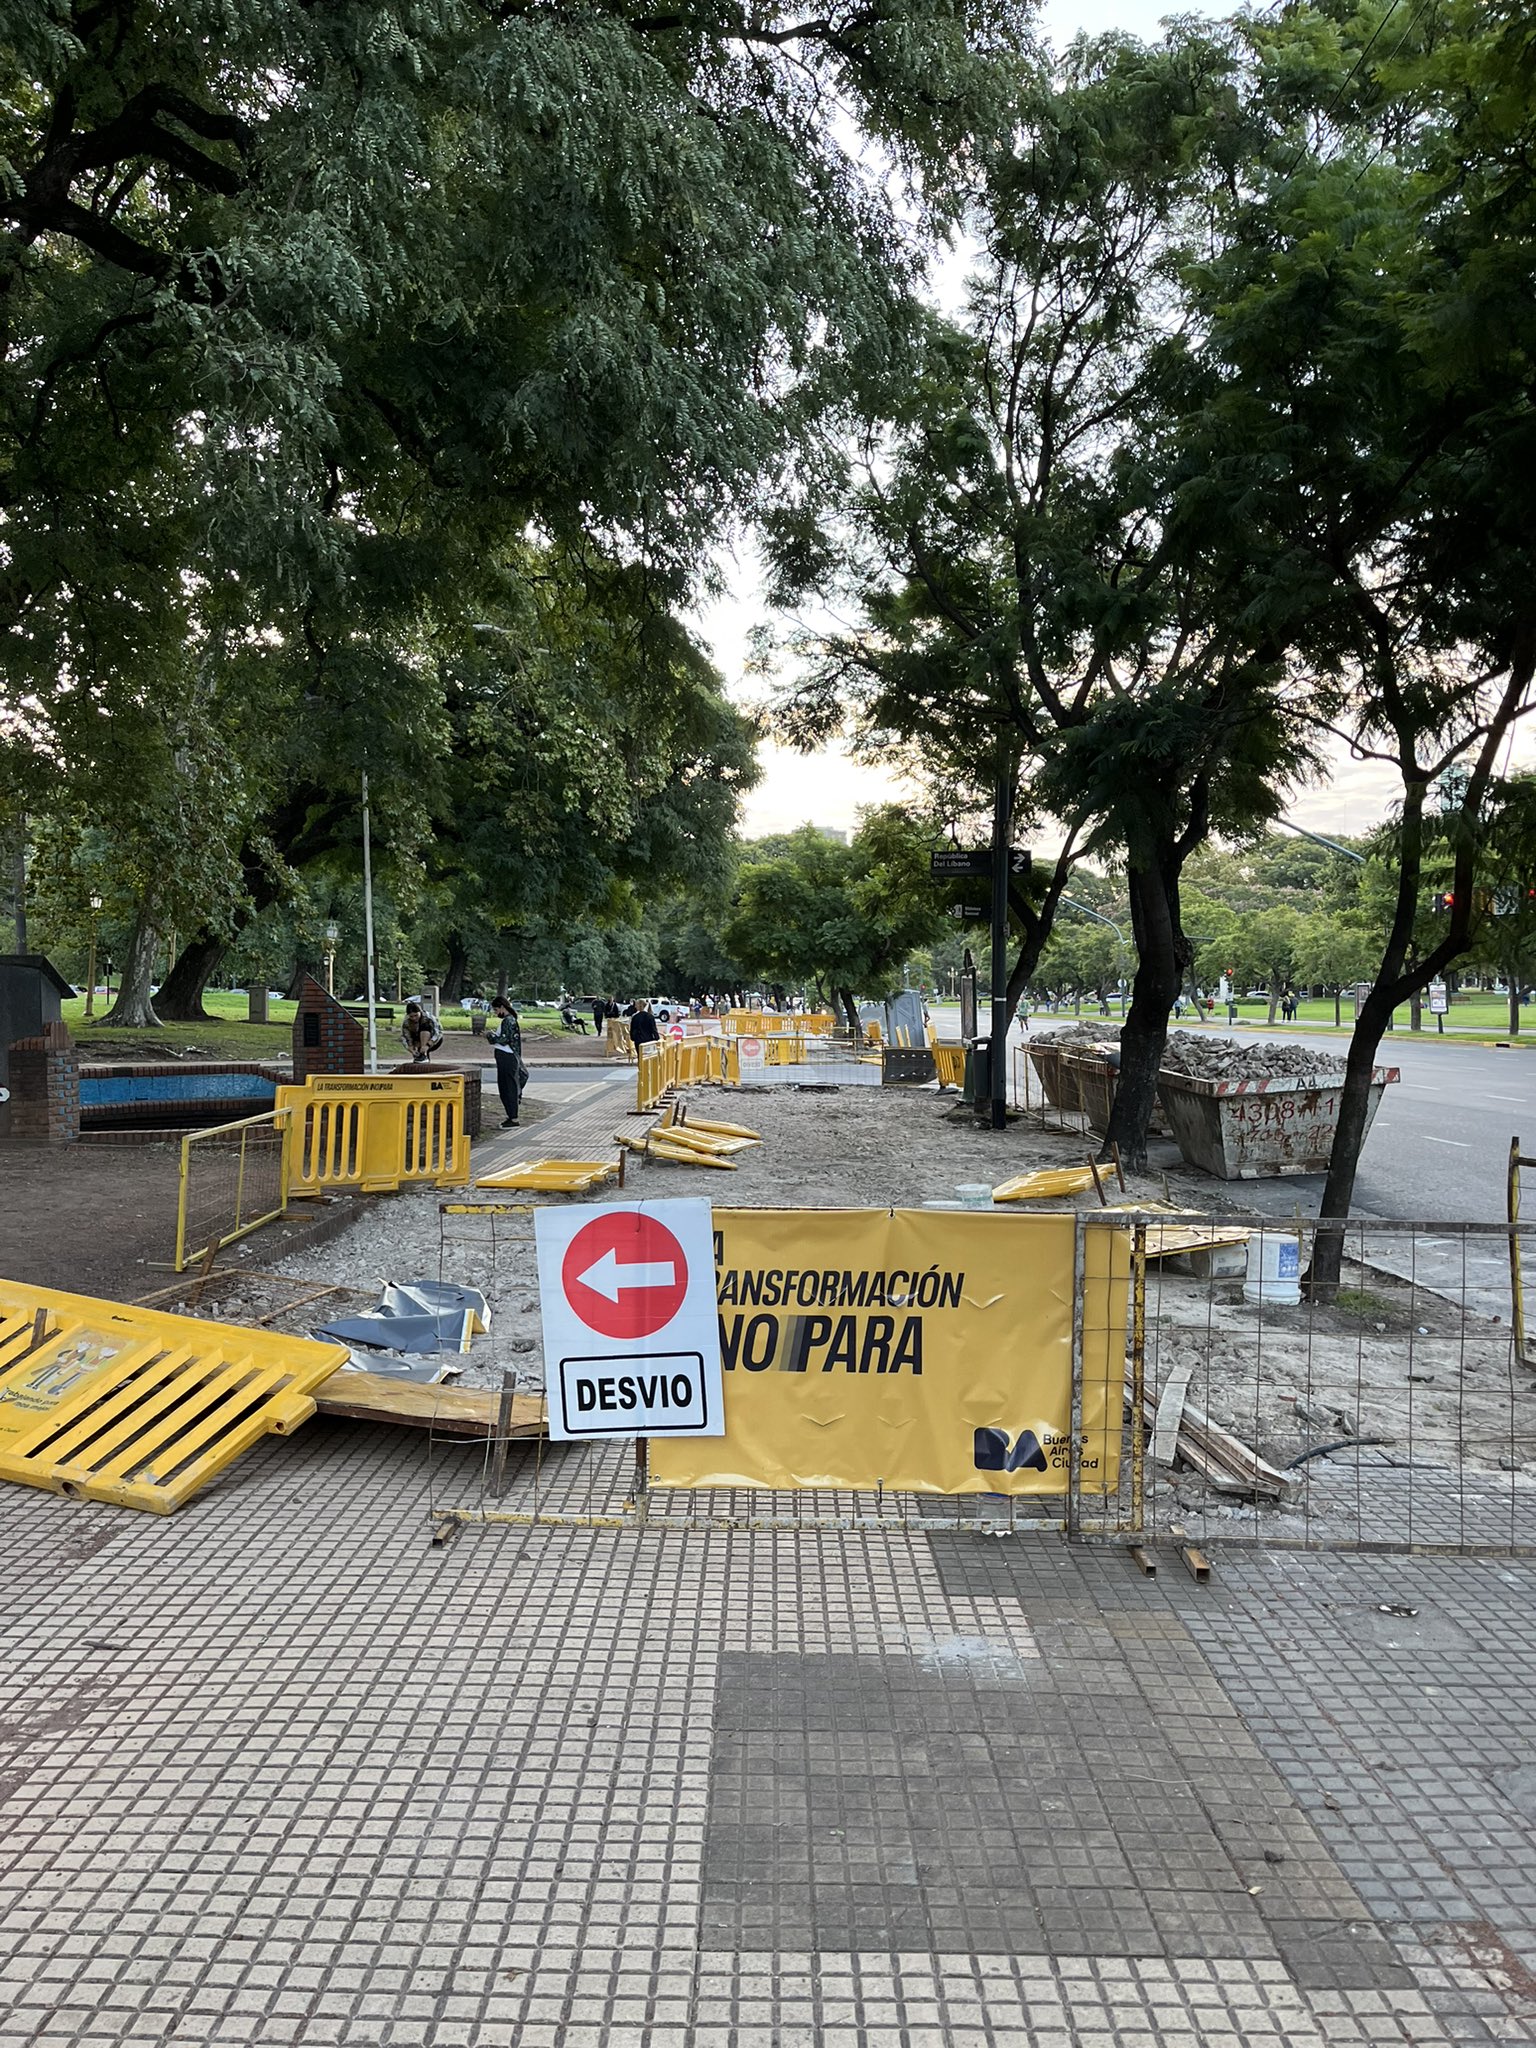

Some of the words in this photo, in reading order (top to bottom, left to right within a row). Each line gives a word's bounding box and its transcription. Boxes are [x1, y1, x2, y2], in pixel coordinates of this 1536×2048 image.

[317, 1083, 324, 1091] LA
[718, 1313, 779, 1372] NO
[797, 1314, 923, 1375] PARA
[576, 1374, 692, 1411] DESVIO
[974, 1427, 1048, 1472] BA
[1052, 1457, 1099, 1468] Ciuad
